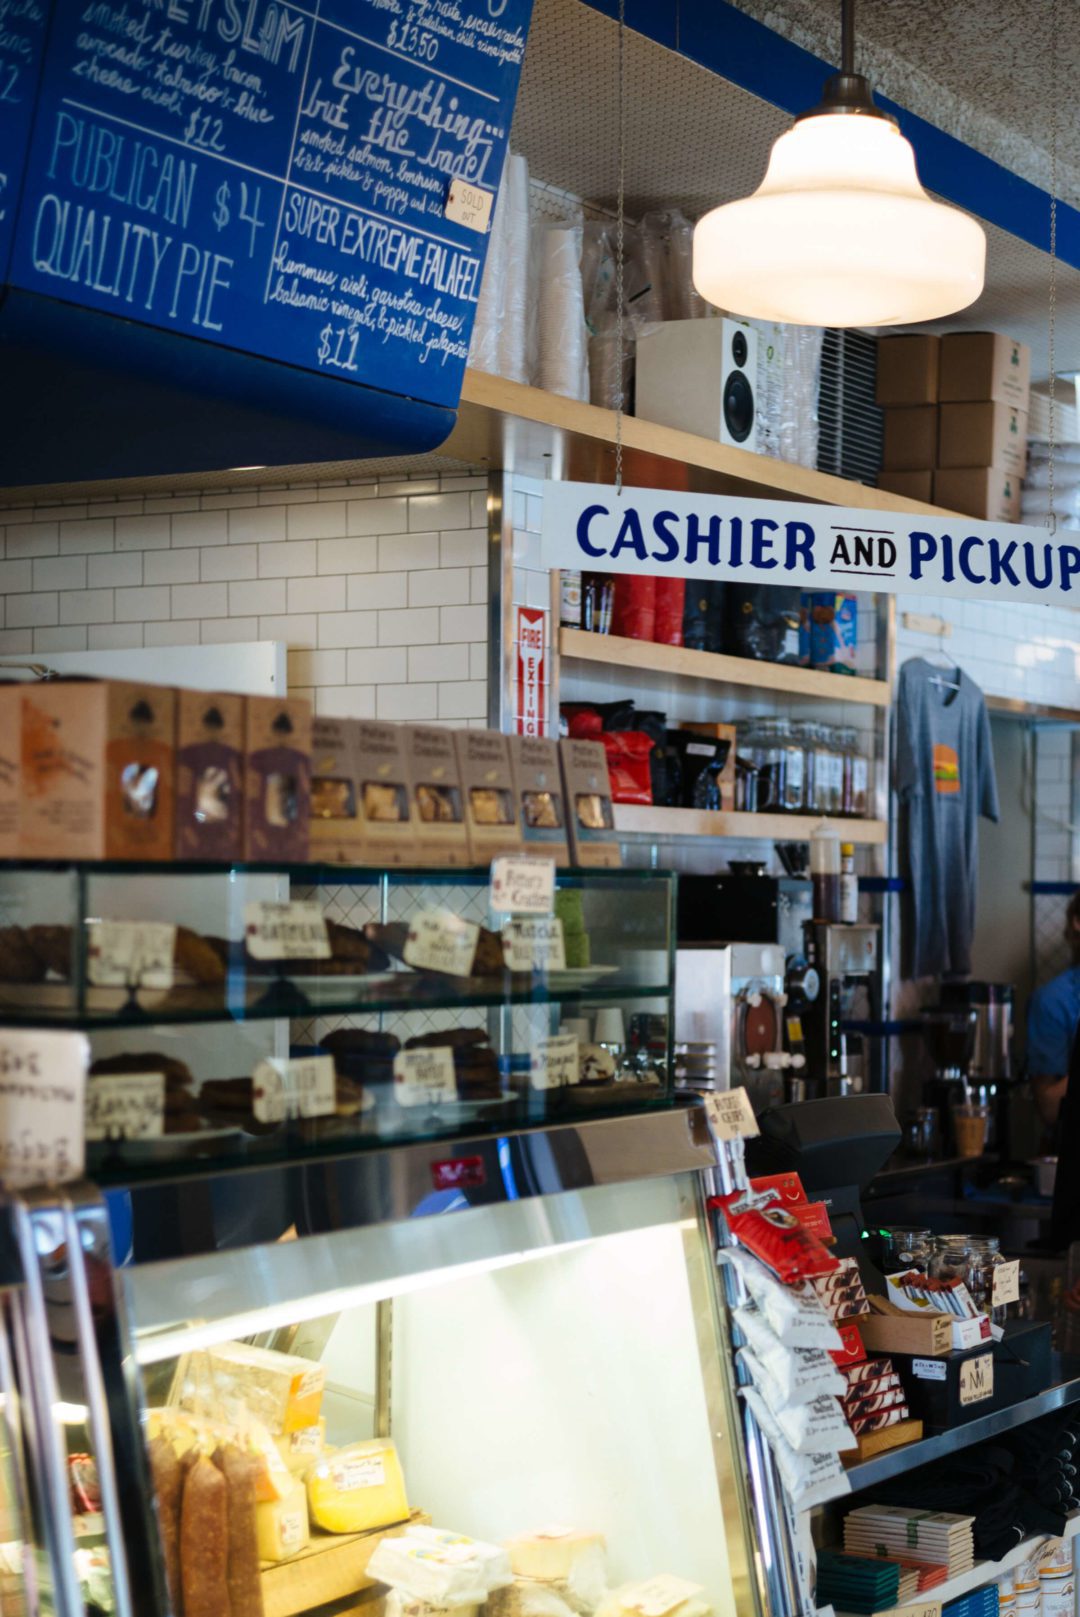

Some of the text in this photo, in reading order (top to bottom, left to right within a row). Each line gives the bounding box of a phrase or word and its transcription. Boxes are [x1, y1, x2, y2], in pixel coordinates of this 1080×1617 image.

[387, 20, 438, 61] $13.50
[72, 55, 140, 93] cheese
[184, 107, 225, 151] $12
[233, 91, 274, 122] blue
[302, 78, 349, 130] but
[361, 107, 415, 157] the
[301, 130, 345, 157] smoked
[47, 112, 197, 228] PUBLICAN
[374, 182, 408, 216] poppy
[410, 193, 426, 212] and
[460, 188, 484, 211] SOLD
[33, 194, 172, 310] QUALITY
[169, 242, 234, 331] PIE
[285, 193, 480, 302] SUPER EXTREME FALAFEL
[270, 276, 328, 311] balsamic
[382, 316, 424, 344] pickled
[318, 323, 360, 370] $11
[576, 504, 1080, 592] CASHIER AND PICKUP
[521, 627, 541, 650] FIRE
[526, 657, 536, 737] EXTING
